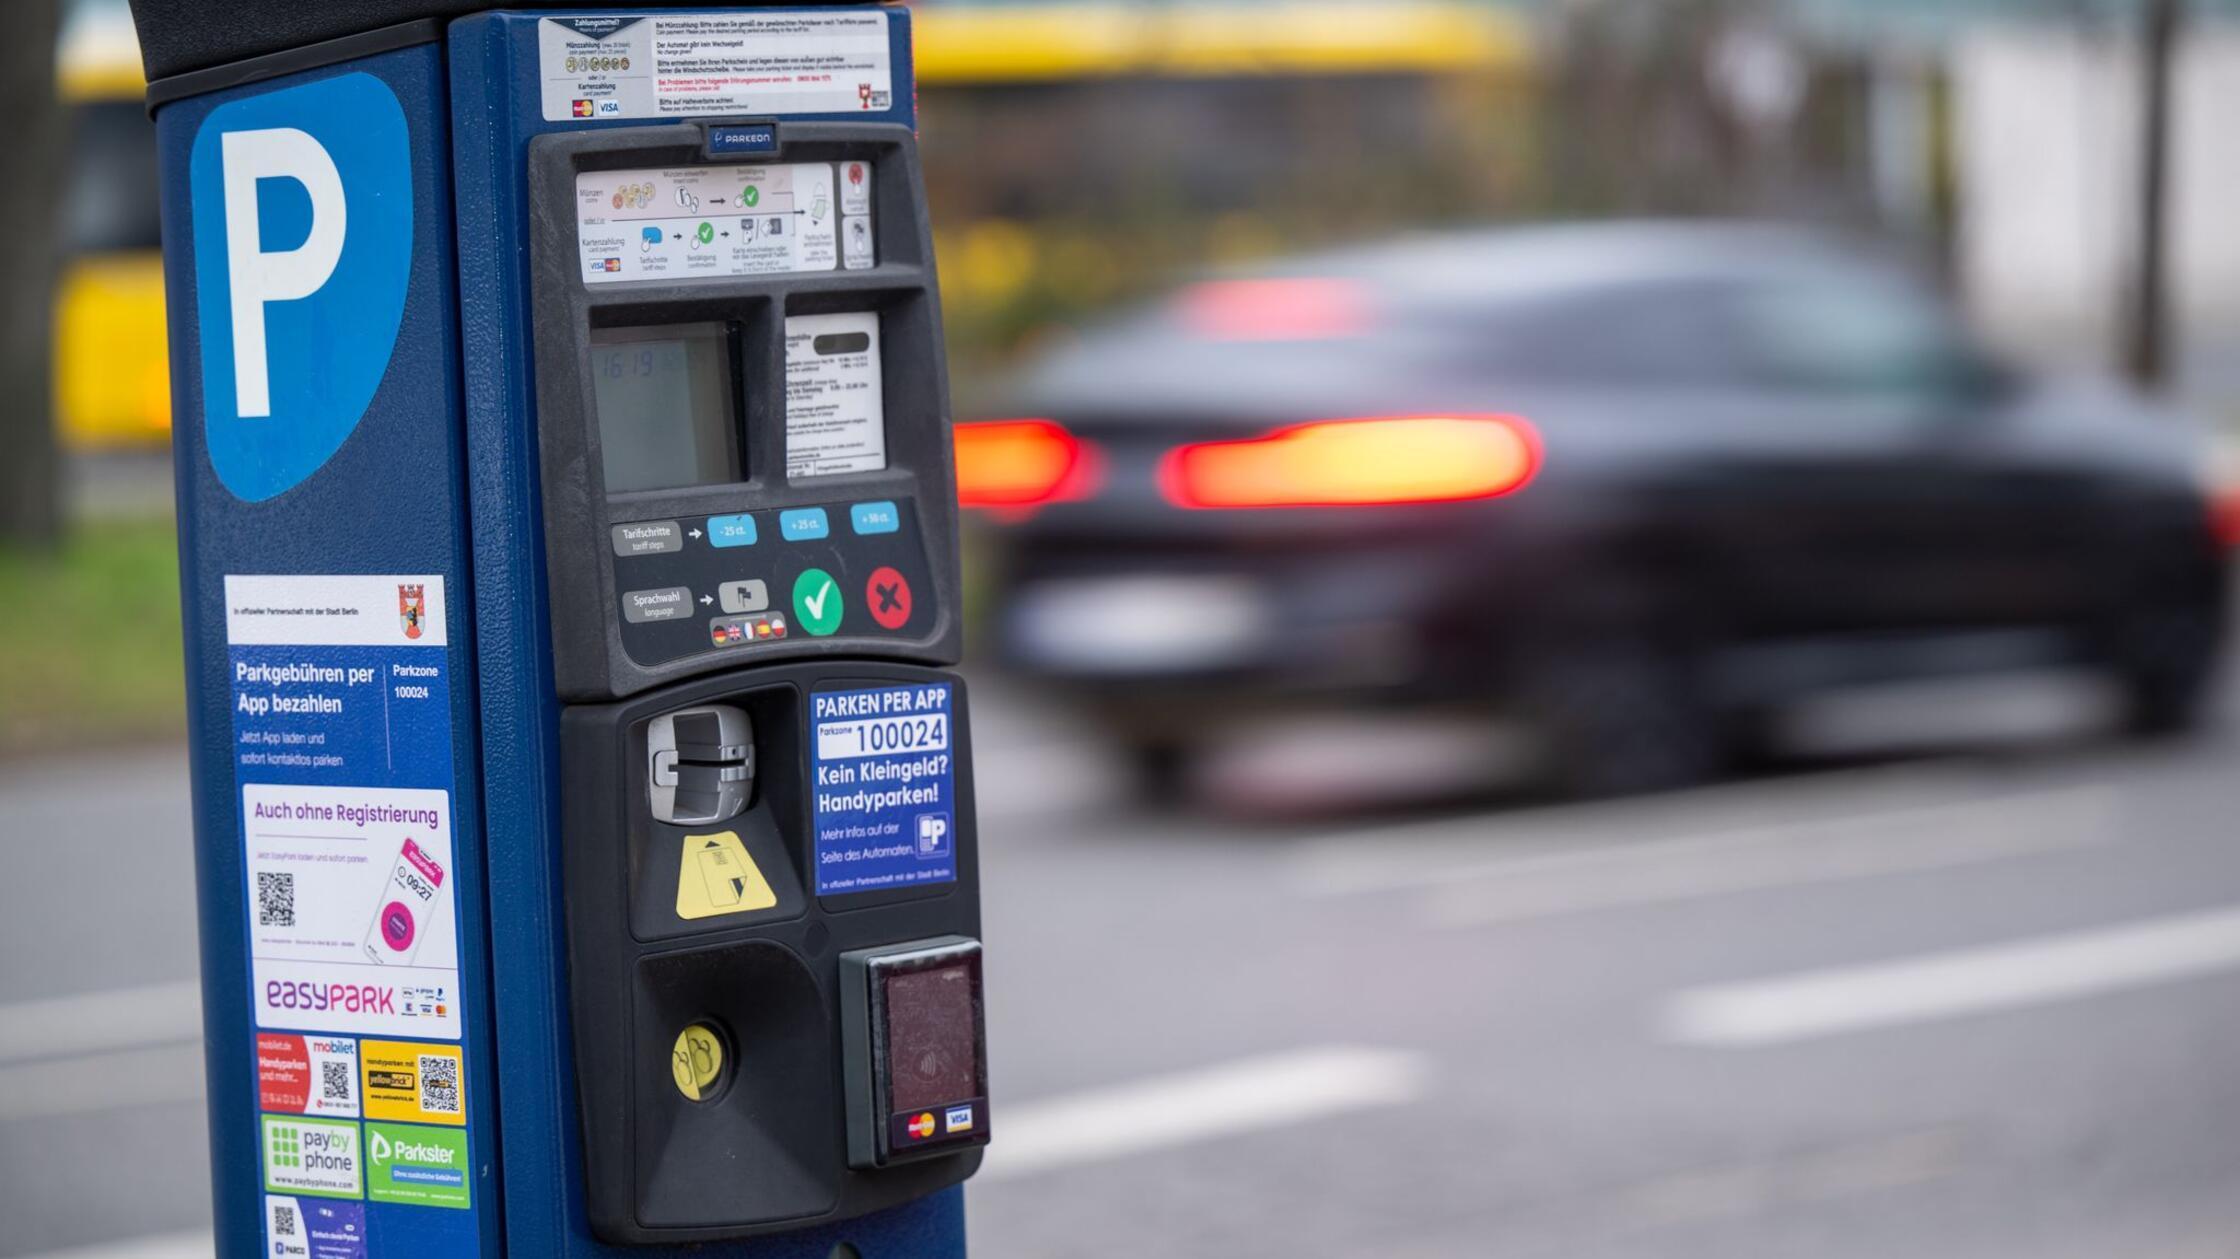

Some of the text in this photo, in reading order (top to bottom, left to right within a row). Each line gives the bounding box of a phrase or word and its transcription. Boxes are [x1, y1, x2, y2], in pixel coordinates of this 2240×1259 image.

[601, 103, 618, 112] VISA
[725, 133, 770, 143] PARKEON
[221, 127, 347, 418] P
[592, 262, 604, 270] VISA
[622, 526, 671, 540] Tarifschritte
[633, 591, 680, 608] Sprachwahl
[236, 661, 374, 686] Parkgebühren per
[393, 664, 438, 677] Parkzone
[394, 686, 428, 698] 100024
[238, 693, 342, 716] App bezahlen
[816, 688, 946, 718] PARKEN PER APP
[240, 731, 325, 746] Jetzt App laden und
[820, 726, 852, 736] Parkzone
[856, 718, 943, 752] 100024
[240, 753, 343, 768] sofort kontaktlos parken
[818, 754, 948, 786] Kein Kleingeld?
[819, 782, 939, 813] Handyparken!
[254, 802, 439, 830] Auch ohne Registrierung
[821, 823, 900, 840] Mehr Infos auf der
[821, 844, 914, 864] Seite des Automaten.
[406, 874, 432, 901] 09:27
[314, 1040, 354, 1054] mobilet
[395, 1140, 455, 1164] Parkster
[305, 1151, 352, 1172] phone
[275, 1177, 353, 1189] www.paybyphone.com
